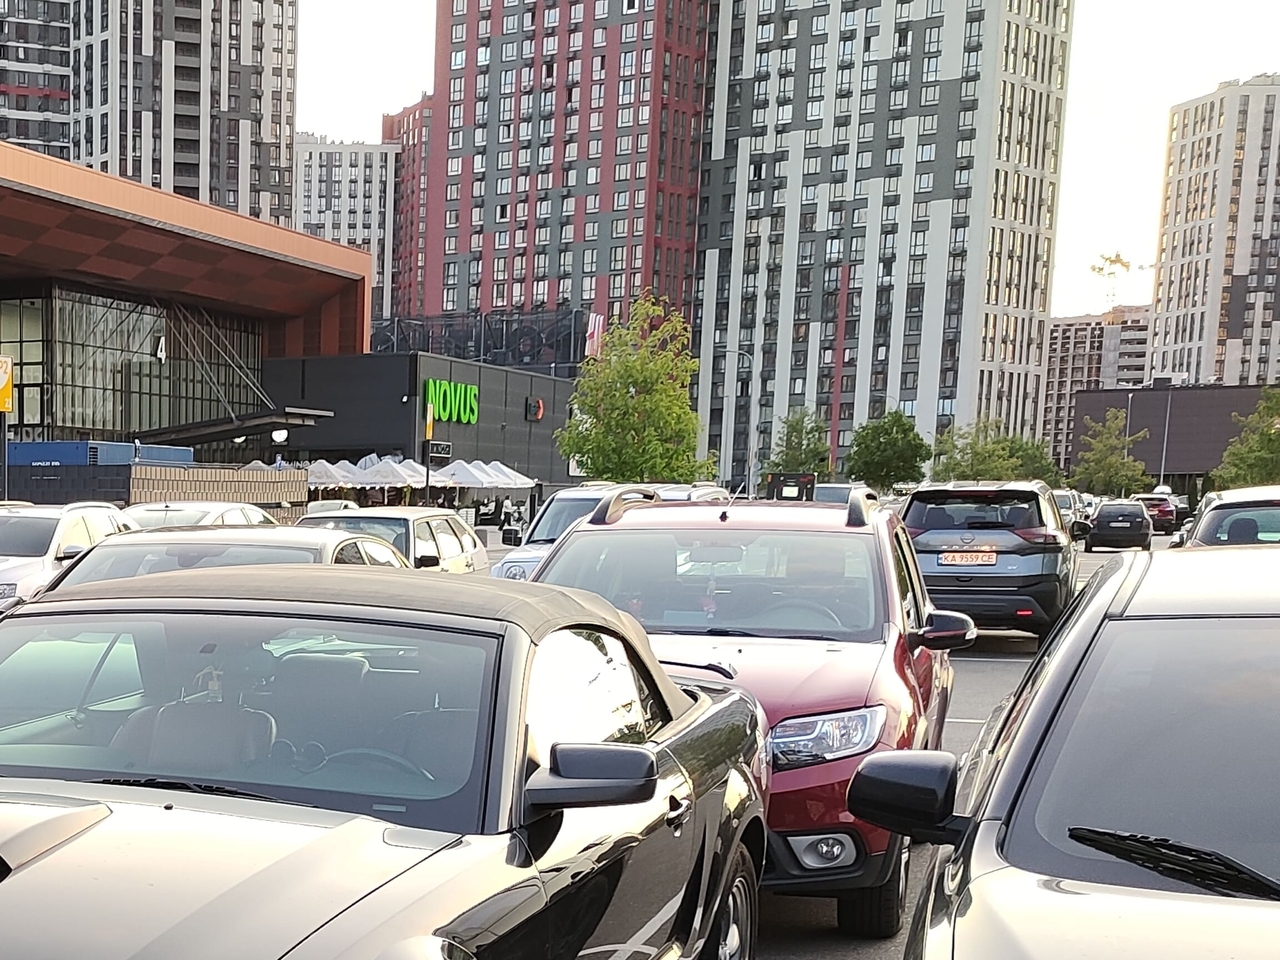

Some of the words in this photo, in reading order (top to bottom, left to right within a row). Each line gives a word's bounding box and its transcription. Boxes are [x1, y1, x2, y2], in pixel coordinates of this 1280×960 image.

[156, 335, 167, 365] 4
[427, 378, 479, 426] NOVUS
[943, 554, 957, 563] KA
[959, 554, 979, 563] 9559
[980, 554, 994, 563] CE
